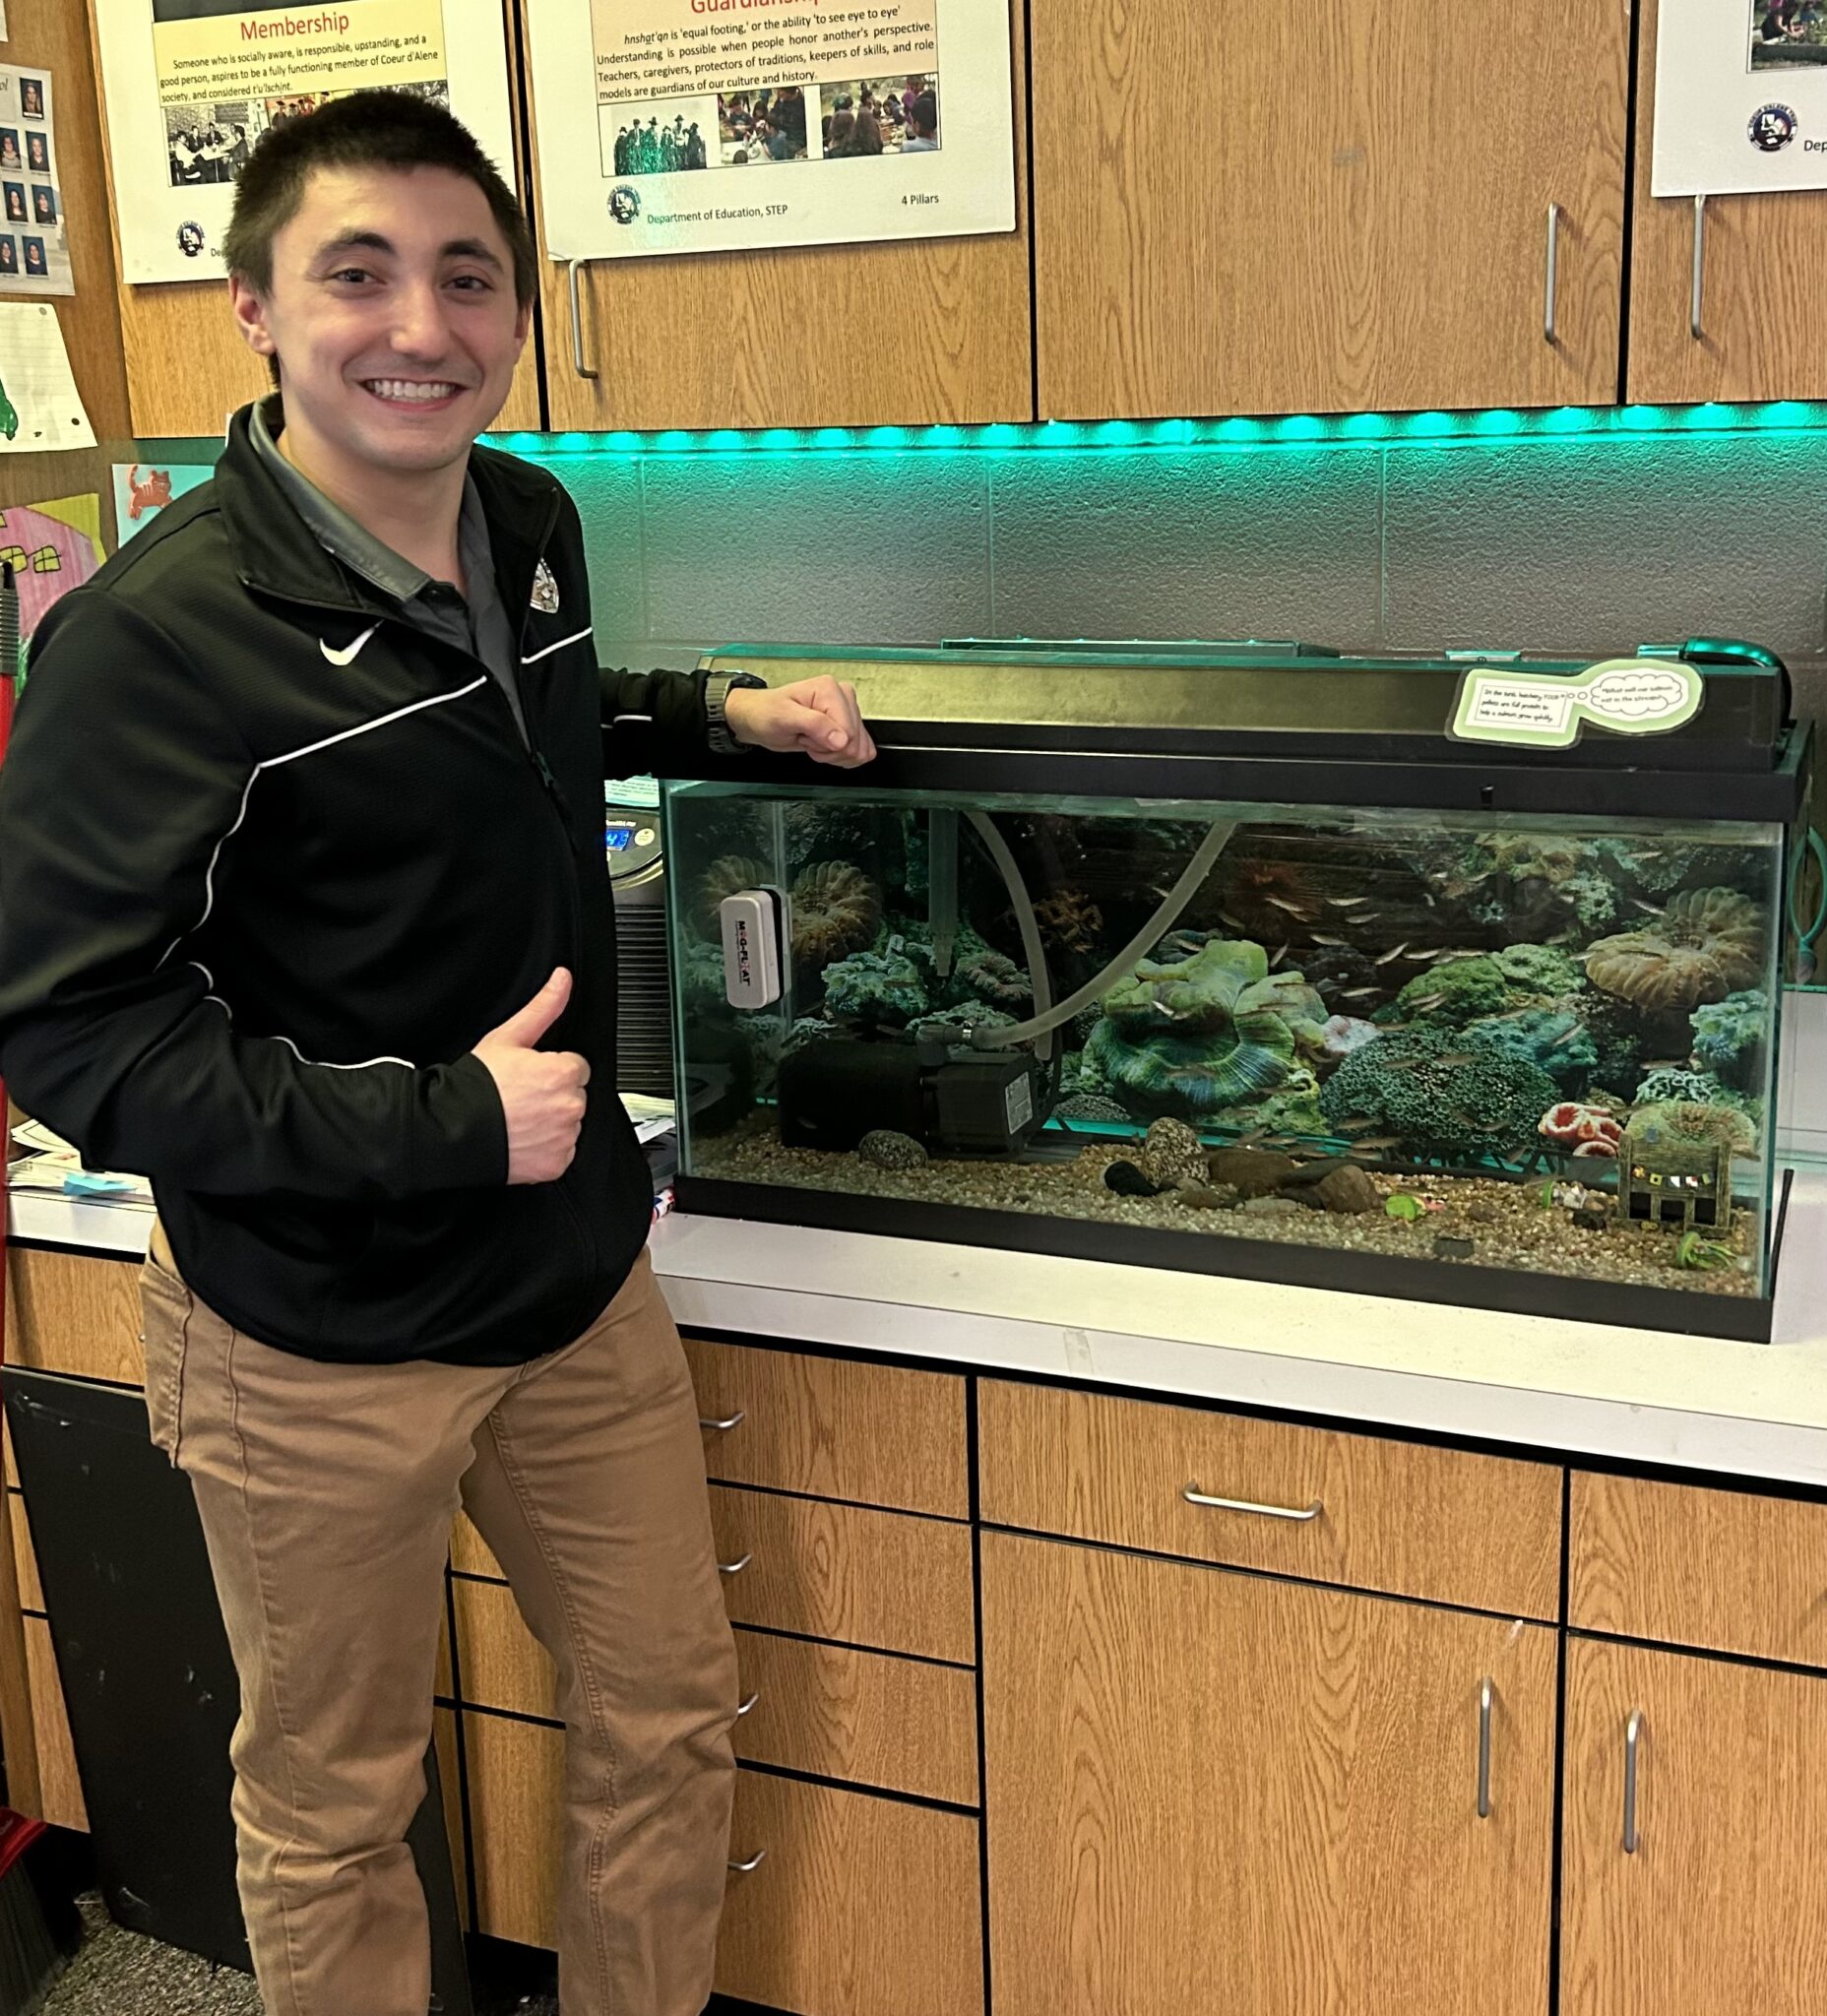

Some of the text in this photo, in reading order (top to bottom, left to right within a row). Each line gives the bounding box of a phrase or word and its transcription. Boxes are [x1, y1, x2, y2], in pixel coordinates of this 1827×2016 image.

[240, 12, 349, 40] Membership
[670, 31, 678, 39] is
[680, 27, 709, 39] 'equal
[751, 23, 761, 32] or
[764, 19, 780, 30] the
[783, 16, 811, 28] ability
[813, 14, 826, 24] 'to
[828, 14, 845, 23] see
[848, 11, 864, 23] eye
[867, 10, 878, 19] to
[880, 5, 901, 19] eye'
[173, 56, 210, 69] Someone
[212, 55, 228, 66] who
[229, 54, 235, 63] is
[238, 51, 266, 63] socially
[268, 49, 294, 59] aware,
[296, 47, 302, 56] is
[305, 43, 352, 56] responsible,
[354, 37, 403, 51] upstanding,
[404, 34, 419, 45] and
[597, 22, 933, 65] Understanding is possible when people honor another's perspective.
[160, 76, 179, 89] good
[181, 75, 210, 87] person,
[212, 71, 238, 83] aspires
[251, 67, 260, 78] be
[270, 65, 285, 77] fully
[288, 61, 333, 75] functioning
[335, 58, 368, 70] member
[371, 54, 379, 65] of
[381, 54, 405, 65] Coeur
[408, 50, 438, 62] d'Alene
[598, 39, 934, 83] Teachers, caregivers, protectors of traditions, keepers of skills, and role
[161, 92, 191, 103] society,
[193, 90, 207, 99] and
[209, 86, 250, 98] considered
[599, 70, 818, 99] models are guardians of our culture and history.
[647, 204, 788, 224] Department of Education, STEP
[901, 193, 939, 205] 4 Pillars
